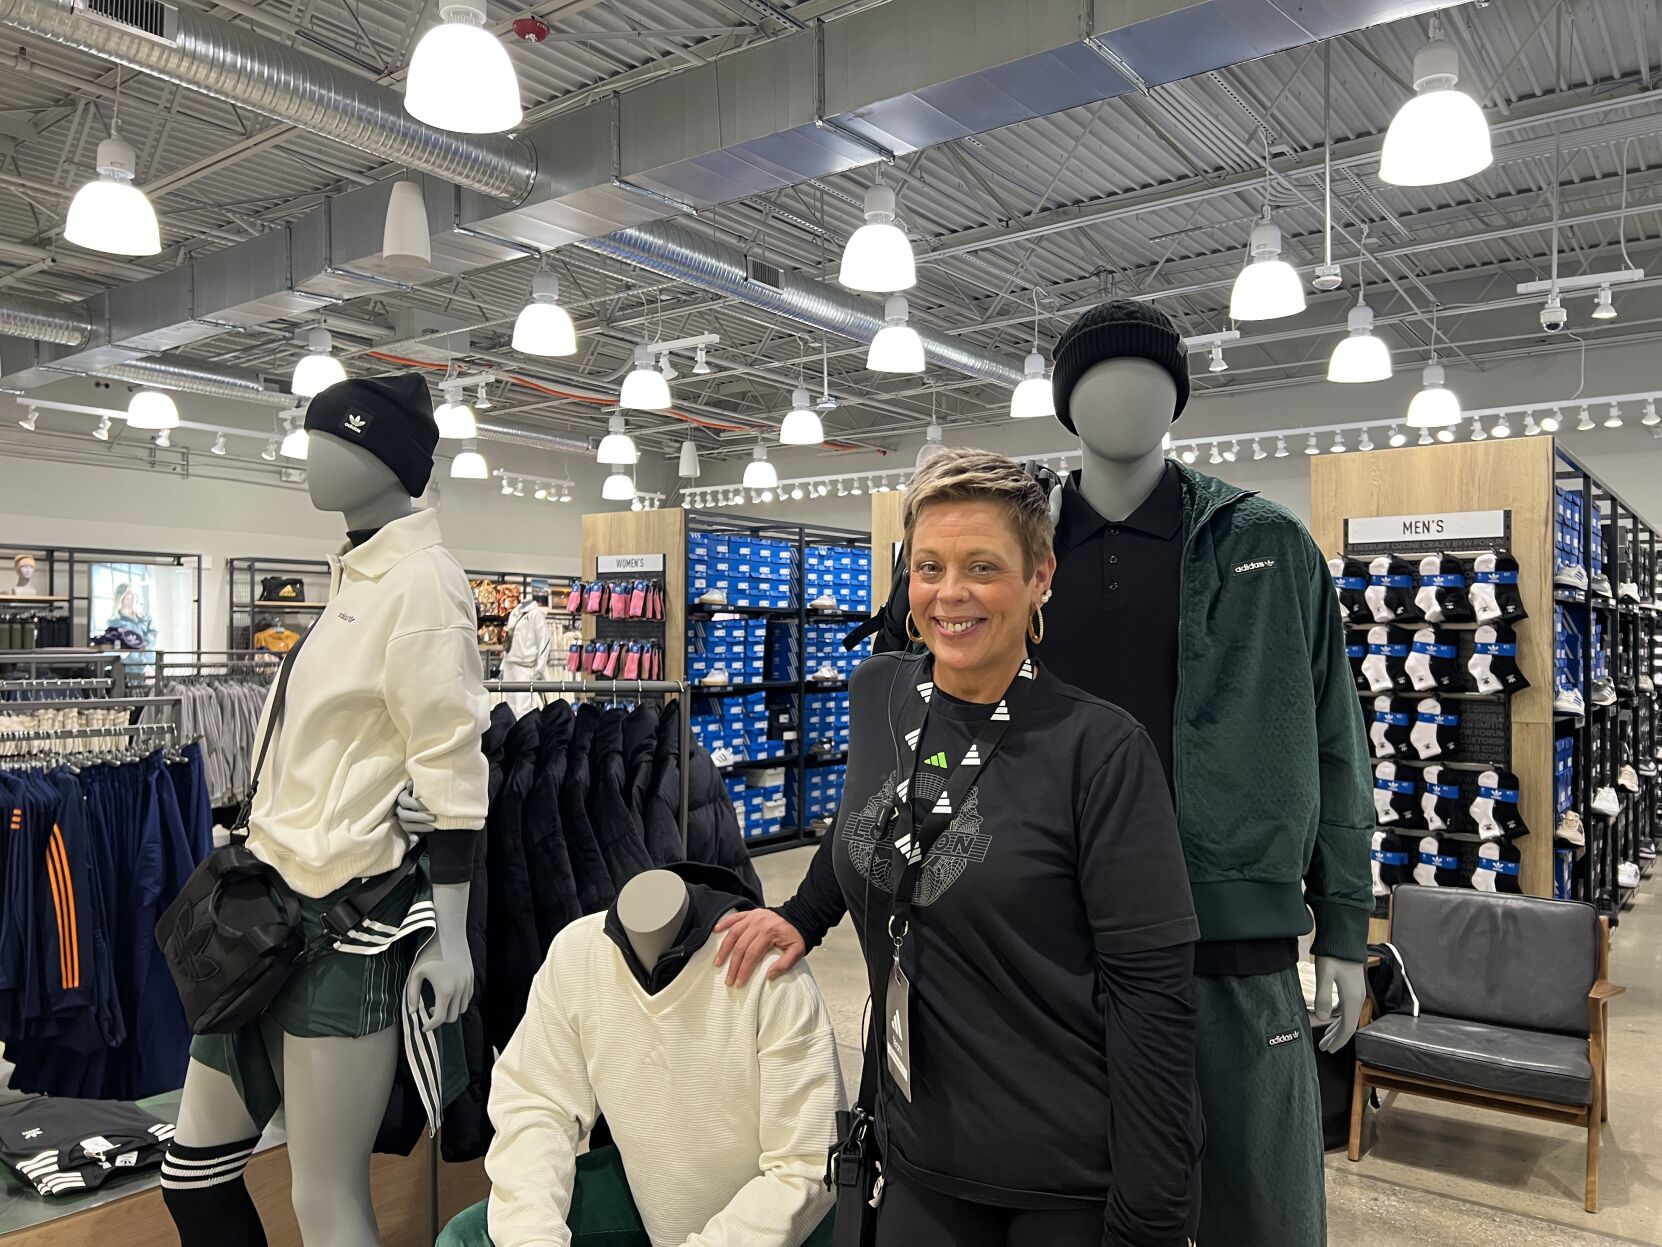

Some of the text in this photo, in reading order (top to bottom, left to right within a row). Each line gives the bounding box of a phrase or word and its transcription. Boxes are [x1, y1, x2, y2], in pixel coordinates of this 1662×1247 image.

[1402, 519, 1444, 535] MEN'S
[1392, 541, 1420, 550] OZONE
[1423, 540, 1451, 548] CRAZY
[616, 558, 645, 568] WOMEN'S
[1235, 562, 1265, 573] adidas
[852, 818, 975, 856] LOON
[1269, 1034, 1293, 1046] adidas
